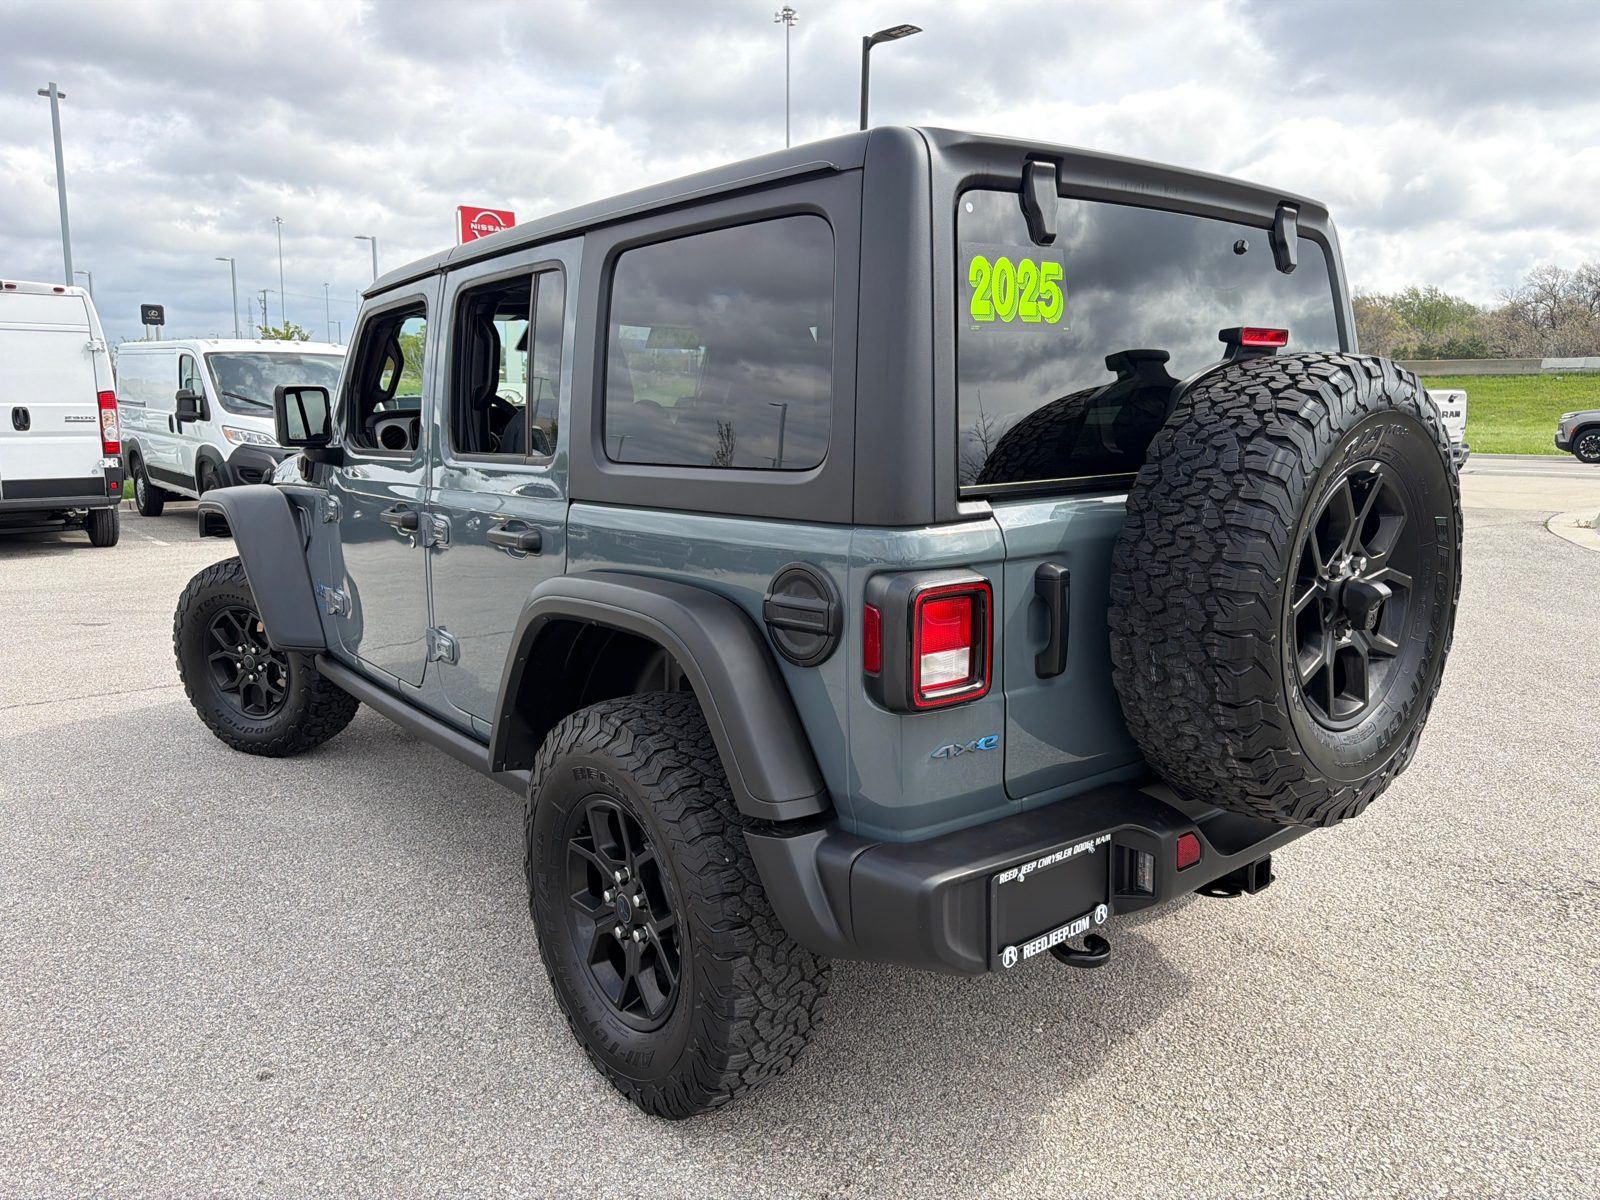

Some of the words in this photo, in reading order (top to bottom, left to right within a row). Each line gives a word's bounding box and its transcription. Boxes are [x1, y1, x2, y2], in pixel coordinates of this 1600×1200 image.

[968, 255, 1064, 324] 2025
[1441, 410, 1461, 419] RAM
[999, 868, 1018, 884] REED
[1019, 861, 1037, 877] JEEP
[1037, 847, 1073, 869] CHRYSLER
[1073, 839, 1095, 855] DODGE
[1095, 833, 1111, 846] RAM
[1023, 916, 1090, 960] REEDJEEP.COM
